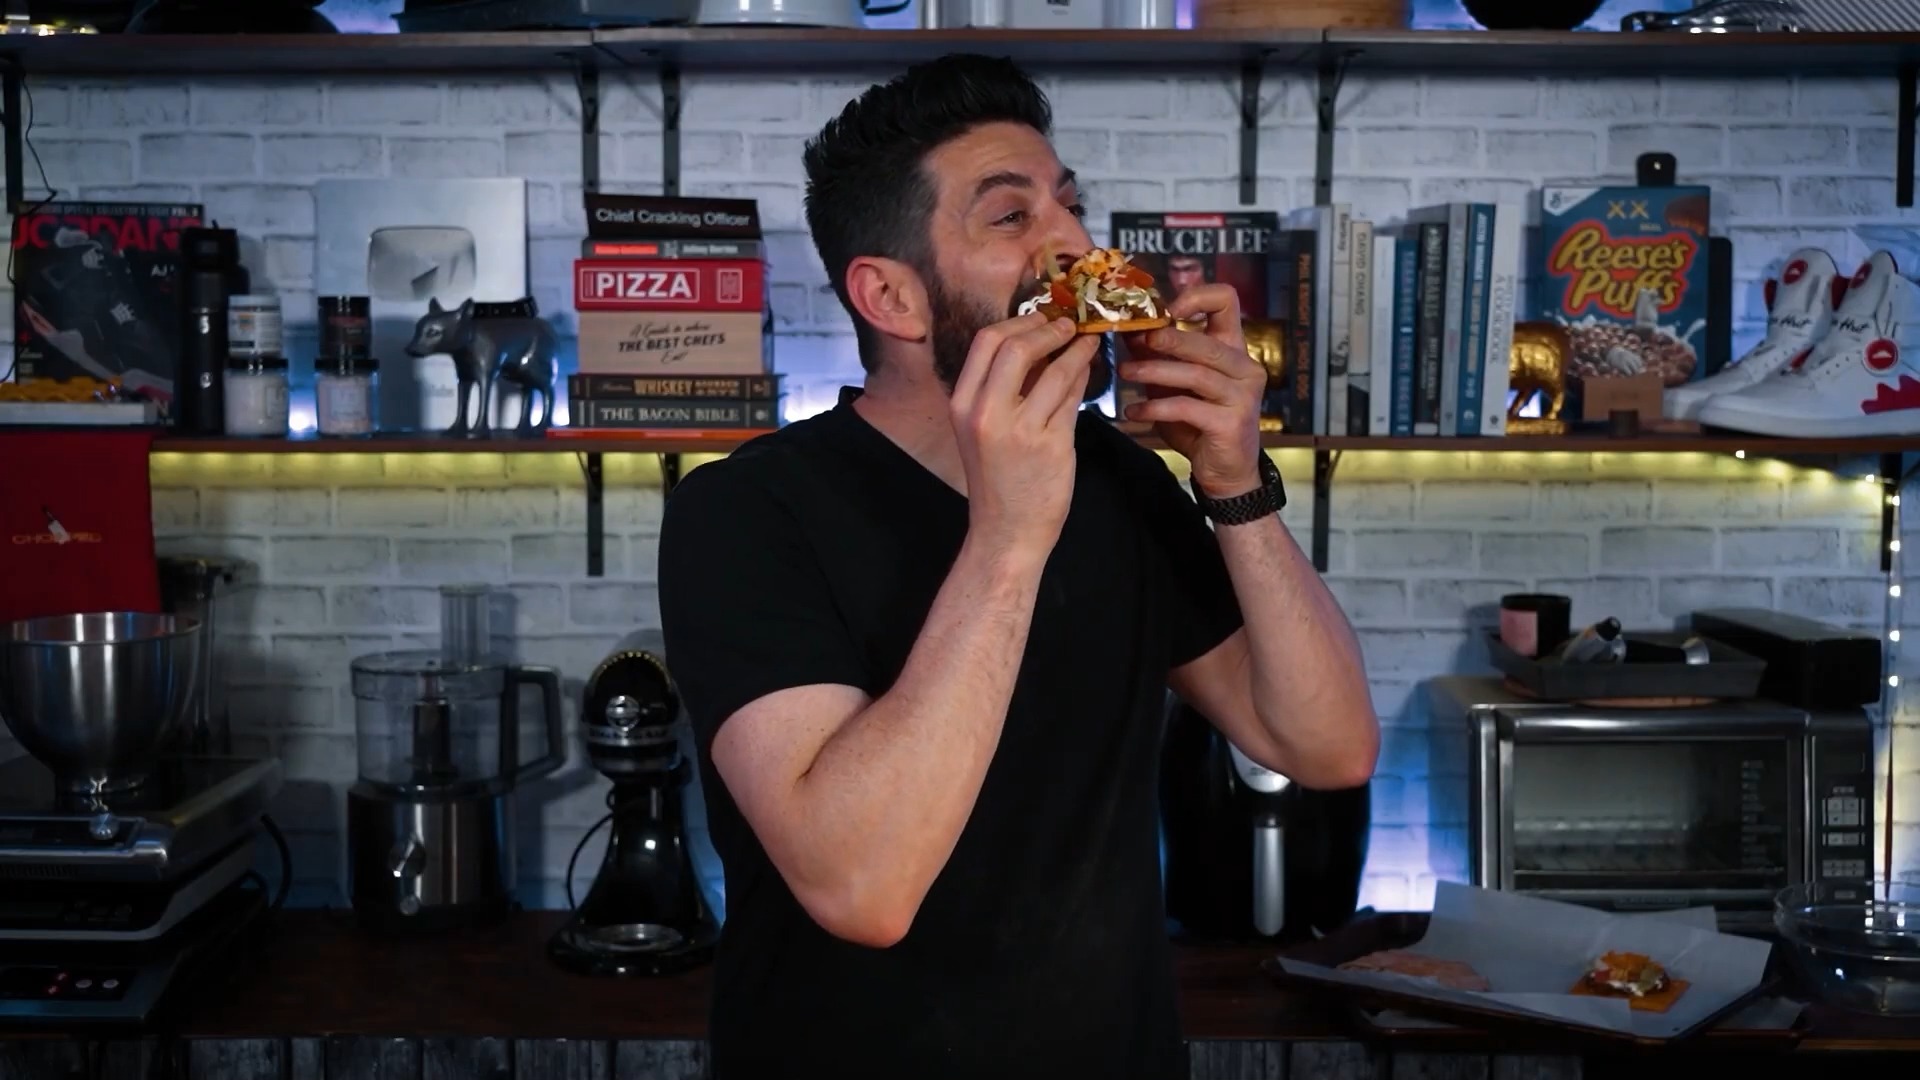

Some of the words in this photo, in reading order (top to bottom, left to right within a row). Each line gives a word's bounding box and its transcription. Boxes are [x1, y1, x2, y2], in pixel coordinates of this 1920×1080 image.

[596, 208, 635, 223] Chief
[637, 210, 701, 228] Cracking
[704, 212, 750, 226] Officer
[1118, 227, 1214, 254] BRUCE
[1356, 232, 1368, 268] DAVID
[1554, 227, 1689, 271] Reese's
[596, 273, 693, 298] PIZZA
[1355, 272, 1367, 316] CHANG
[1570, 267, 1681, 312] Puffs
[618, 340, 643, 353] THE
[646, 335, 681, 351] BEST
[683, 332, 726, 348] CHEFS
[634, 379, 693, 396] WHISKEY
[600, 408, 634, 422] THE
[637, 408, 691, 422] BACON
[695, 408, 740, 422] BIBLE
